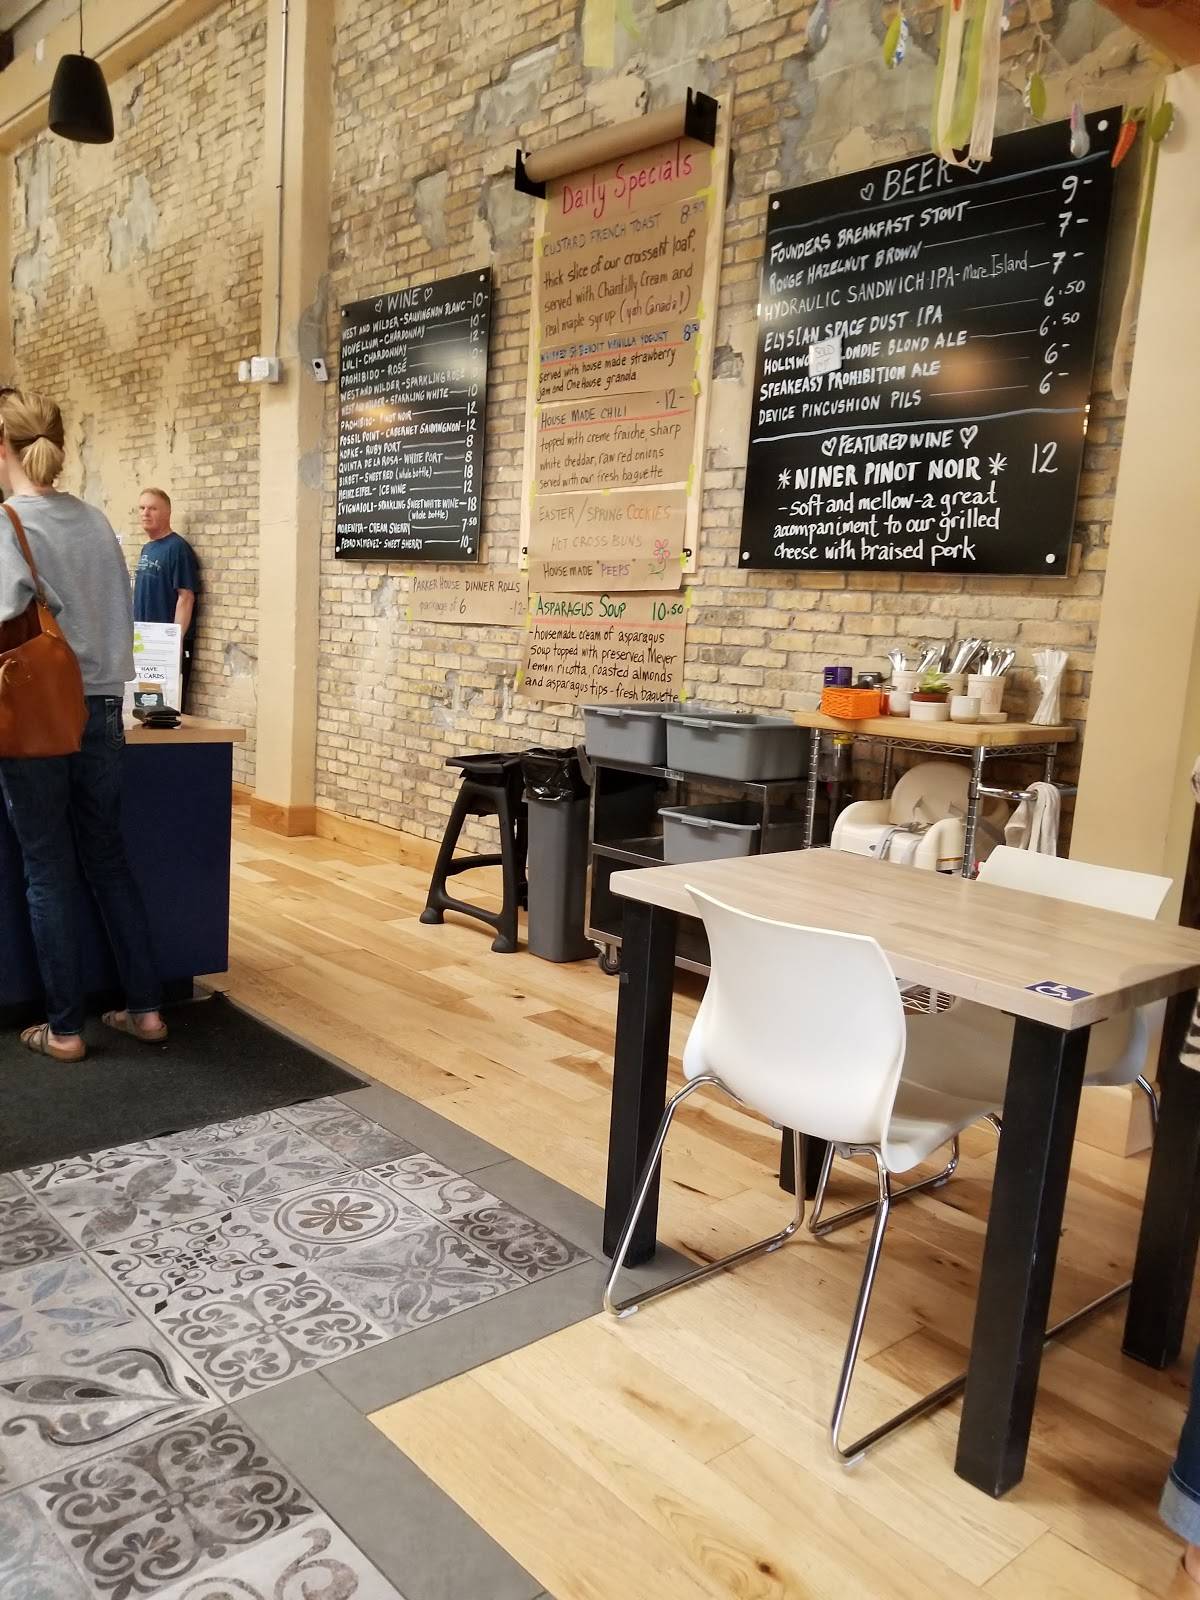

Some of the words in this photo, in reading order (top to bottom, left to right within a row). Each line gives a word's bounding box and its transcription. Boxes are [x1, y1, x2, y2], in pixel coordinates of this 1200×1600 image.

[563, 173, 605, 219] Daily
[614, 141, 693, 209] Specials
[883, 157, 953, 201] BEER
[590, 223, 625, 240] FRENCH
[629, 211, 661, 232] TOAST
[770, 233, 831, 266] FOUNDERS
[837, 214, 915, 249] BREAKFAST
[920, 200, 971, 227] STOUT
[567, 261, 588, 282] slice
[591, 254, 604, 274] of
[604, 257, 621, 271] our
[807, 253, 870, 286] HAZELNUT
[874, 240, 923, 268] BROWN
[387, 287, 422, 313] WINE
[544, 289, 572, 313] served
[575, 284, 595, 303] with
[672, 262, 694, 281] and
[764, 289, 841, 321] HYDRAULIC
[847, 271, 925, 303] SANDWICH
[372, 316, 399, 333] WILDER
[589, 310, 617, 333] syrup
[764, 326, 820, 353] ELYSIAN
[824, 316, 868, 340] SPACE
[869, 311, 910, 333] DUST
[916, 304, 943, 327] IPA
[384, 325, 425, 345] CHARDONNAY
[888, 336, 929, 356] BLOND
[934, 330, 968, 349] ALE
[363, 344, 407, 365] CHARDONNAY
[564, 363, 579, 377] with
[582, 360, 602, 373] house
[604, 354, 627, 368] made
[630, 347, 676, 367] strawberry
[340, 368, 380, 388] PROHIBIDO
[373, 379, 400, 394] WILDER
[552, 379, 564, 394] and
[603, 368, 637, 391] granola
[759, 375, 824, 401] SPEAKEASY
[828, 365, 906, 391] PROHIBITION
[911, 360, 941, 378] ALE
[426, 387, 449, 401] WHITE
[467, 383, 478, 397] 10
[466, 400, 478, 416] 12
[541, 412, 567, 429] HOUSE
[571, 407, 596, 422] MADE
[600, 405, 627, 419] CHILI
[758, 405, 796, 426] DEVICE
[802, 394, 881, 418] PINCUSHION
[890, 389, 922, 409] PILS
[340, 433, 361, 446] FOSSIL
[362, 430, 380, 442] POINT
[385, 424, 419, 438] CABERNET
[466, 418, 477, 433] 12
[365, 443, 382, 456] RUBY
[383, 441, 402, 453] PORT
[466, 434, 474, 448] 8
[539, 431, 565, 454] topped
[567, 430, 584, 446] with
[649, 419, 682, 439] sharp
[838, 432, 908, 457] FEATURED
[909, 428, 954, 450] WINE
[338, 459, 363, 474] QUINTA
[364, 458, 373, 469] DE
[381, 455, 399, 467] ROSA
[403, 452, 424, 465] WHITE
[424, 451, 444, 465] PORT
[464, 450, 473, 463] 8
[382, 470, 394, 480] RED
[463, 464, 474, 479] 18
[540, 456, 561, 471] white
[598, 452, 616, 464] raw
[617, 447, 633, 463] red
[634, 448, 665, 461] onions
[864, 460, 922, 485] PINOT
[1031, 441, 1058, 474] 12
[378, 484, 390, 497] ICE
[390, 483, 407, 495] WINE
[463, 479, 473, 495] 12
[539, 473, 561, 490] served
[562, 472, 579, 487] with
[580, 473, 594, 485] our
[597, 467, 619, 482] fresh
[622, 464, 664, 483] baguette
[442, 497, 460, 509] WINE
[467, 496, 477, 512] 18
[825, 491, 854, 513] and
[940, 480, 998, 517] great
[626, 503, 672, 521] COOKIES
[883, 513, 902, 534] to
[906, 517, 936, 533] our
[936, 507, 1000, 543] grilled
[551, 536, 569, 552] HOT
[572, 535, 608, 548] CROSS
[611, 534, 642, 548] BUNS
[774, 542, 819, 560] cheese
[824, 537, 856, 560] with
[861, 537, 924, 560] braised
[931, 535, 976, 567] pork
[413, 576, 438, 592] PARKER
[439, 576, 460, 590] HOUSE
[465, 580, 495, 592] DINNER
[497, 580, 521, 593] ROLLS
[459, 598, 467, 614] 6
[536, 595, 594, 617] ASPARAGUS
[652, 602, 684, 621] 10.50
[578, 629, 601, 641] cream
[603, 625, 615, 641] of
[618, 630, 665, 649] asparagus
[553, 642, 578, 660] topped
[581, 643, 598, 661] with
[602, 647, 645, 664] preserved
[648, 647, 678, 669] Meyer
[527, 658, 554, 672] lemon
[592, 663, 630, 678] roasted
[632, 666, 673, 683] almonds
[524, 676, 544, 687] and
[546, 679, 588, 698] asparagus
[590, 678, 608, 699] tips
[616, 682, 639, 701] fresh
[640, 686, 679, 703] baguette
